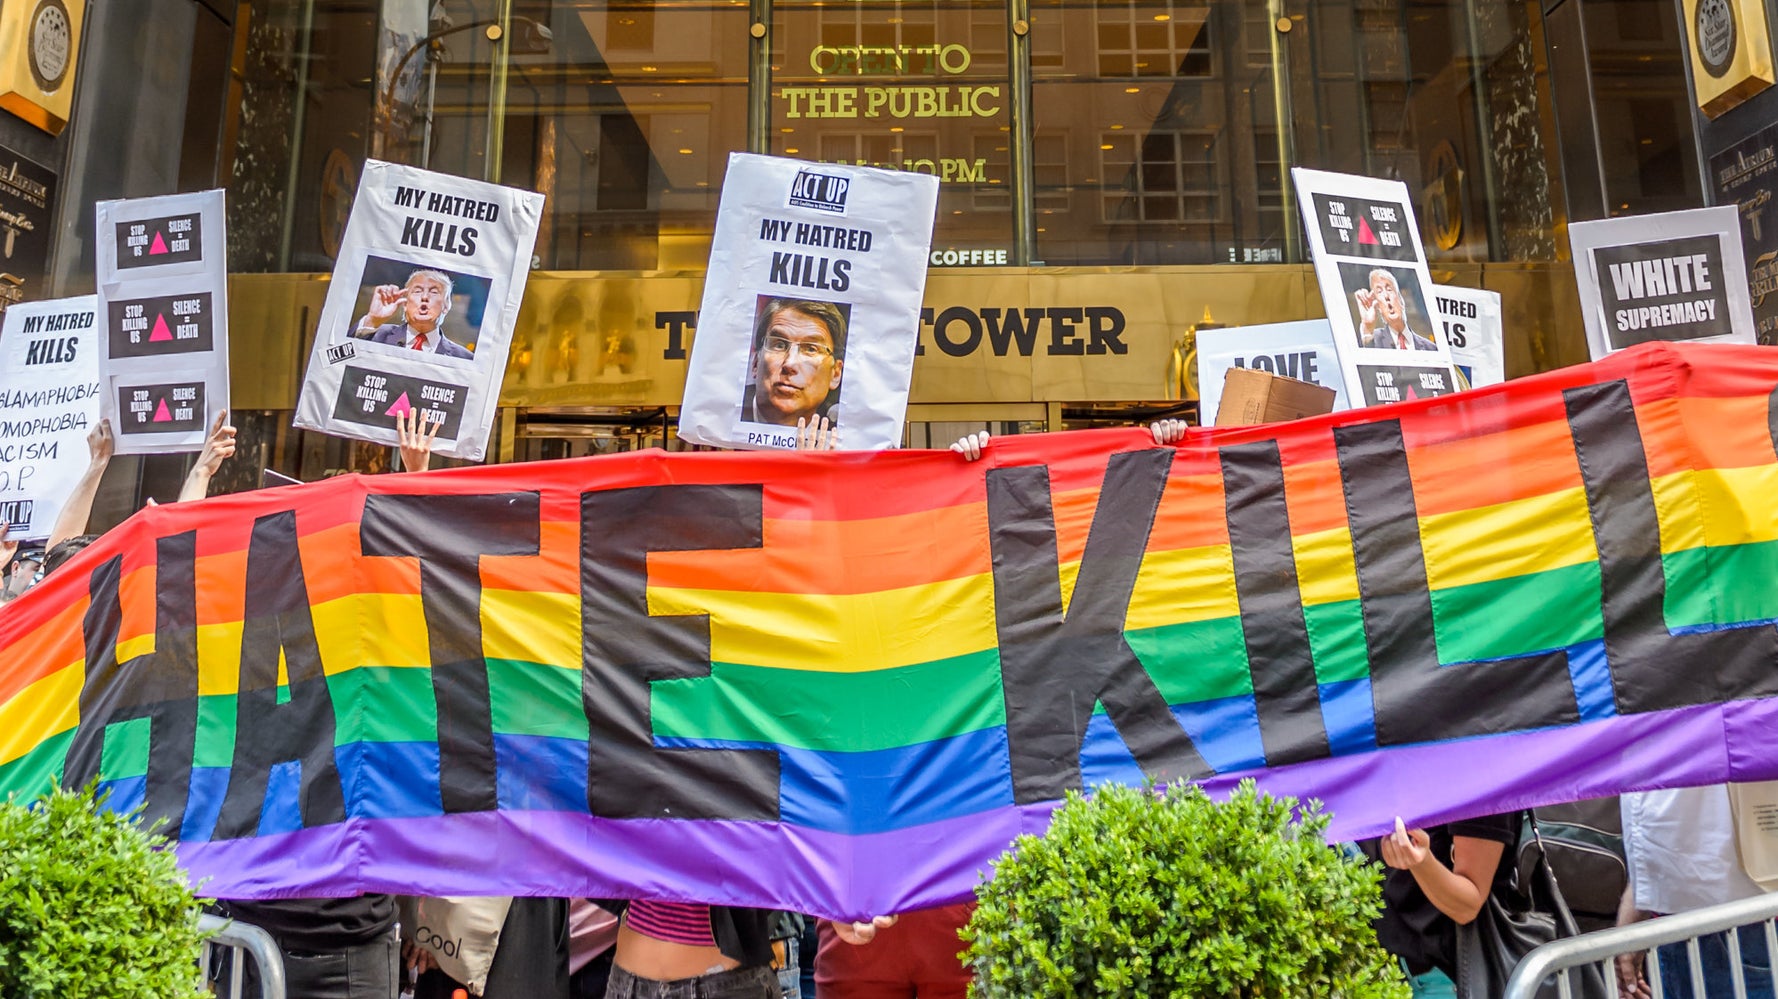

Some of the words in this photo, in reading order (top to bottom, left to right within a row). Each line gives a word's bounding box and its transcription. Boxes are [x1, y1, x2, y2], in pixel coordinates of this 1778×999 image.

[810, 44, 911, 74] OPEN
[917, 44, 971, 74] TO
[782, 87, 857, 118] THE
[864, 86, 1000, 117] PUBLIC
[792, 172, 823, 200] ACT
[825, 177, 847, 203] UP
[394, 186, 426, 209] MY
[428, 192, 500, 223] HATRED
[1329, 200, 1345, 215] STOP
[1328, 214, 1353, 229] KILLING
[1370, 206, 1398, 223] SILENCE
[130, 224, 145, 237] STOP
[168, 218, 192, 233] SILENCE
[400, 216, 479, 256] KILLS
[760, 219, 792, 242] MY
[795, 223, 873, 252] HATRED
[134, 246, 142, 257] US
[171, 238, 190, 252] DEATH
[930, 249, 1007, 265] COFFEE
[769, 252, 852, 292] KILLS
[1609, 254, 1712, 300] WHITE
[125, 305, 144, 319] STOP
[173, 299, 201, 315] SILENCE
[1436, 296, 1476, 319] TRED
[1616, 299, 1715, 331] SUPREMACY
[23, 315, 47, 334] MY
[47, 311, 95, 332] HATRED
[122, 316, 148, 332] KILLING
[130, 330, 141, 344] US
[176, 324, 199, 340] DEATH
[25, 337, 79, 366] KILLS
[328, 347, 342, 361] ACT
[342, 343, 354, 356] UP
[1234, 351, 1319, 385] VE
[364, 374, 387, 390] STOP
[1376, 371, 1393, 386] STOP
[133, 390, 149, 402] STOP
[173, 387, 196, 401] SILENCE
[356, 385, 388, 403] KILLING
[421, 385, 456, 404] SILENCE
[175, 407, 193, 421] DEATH
[363, 399, 376, 413] US
[137, 411, 147, 423] US
[420, 407, 447, 425] DEATH
[748, 432, 770, 445] PAT
[0, 502, 18, 524] ACT
[19, 501, 32, 522] UP
[62, 484, 780, 842] HATE
[985, 378, 1778, 807] KILL
[416, 926, 462, 959] Cool
